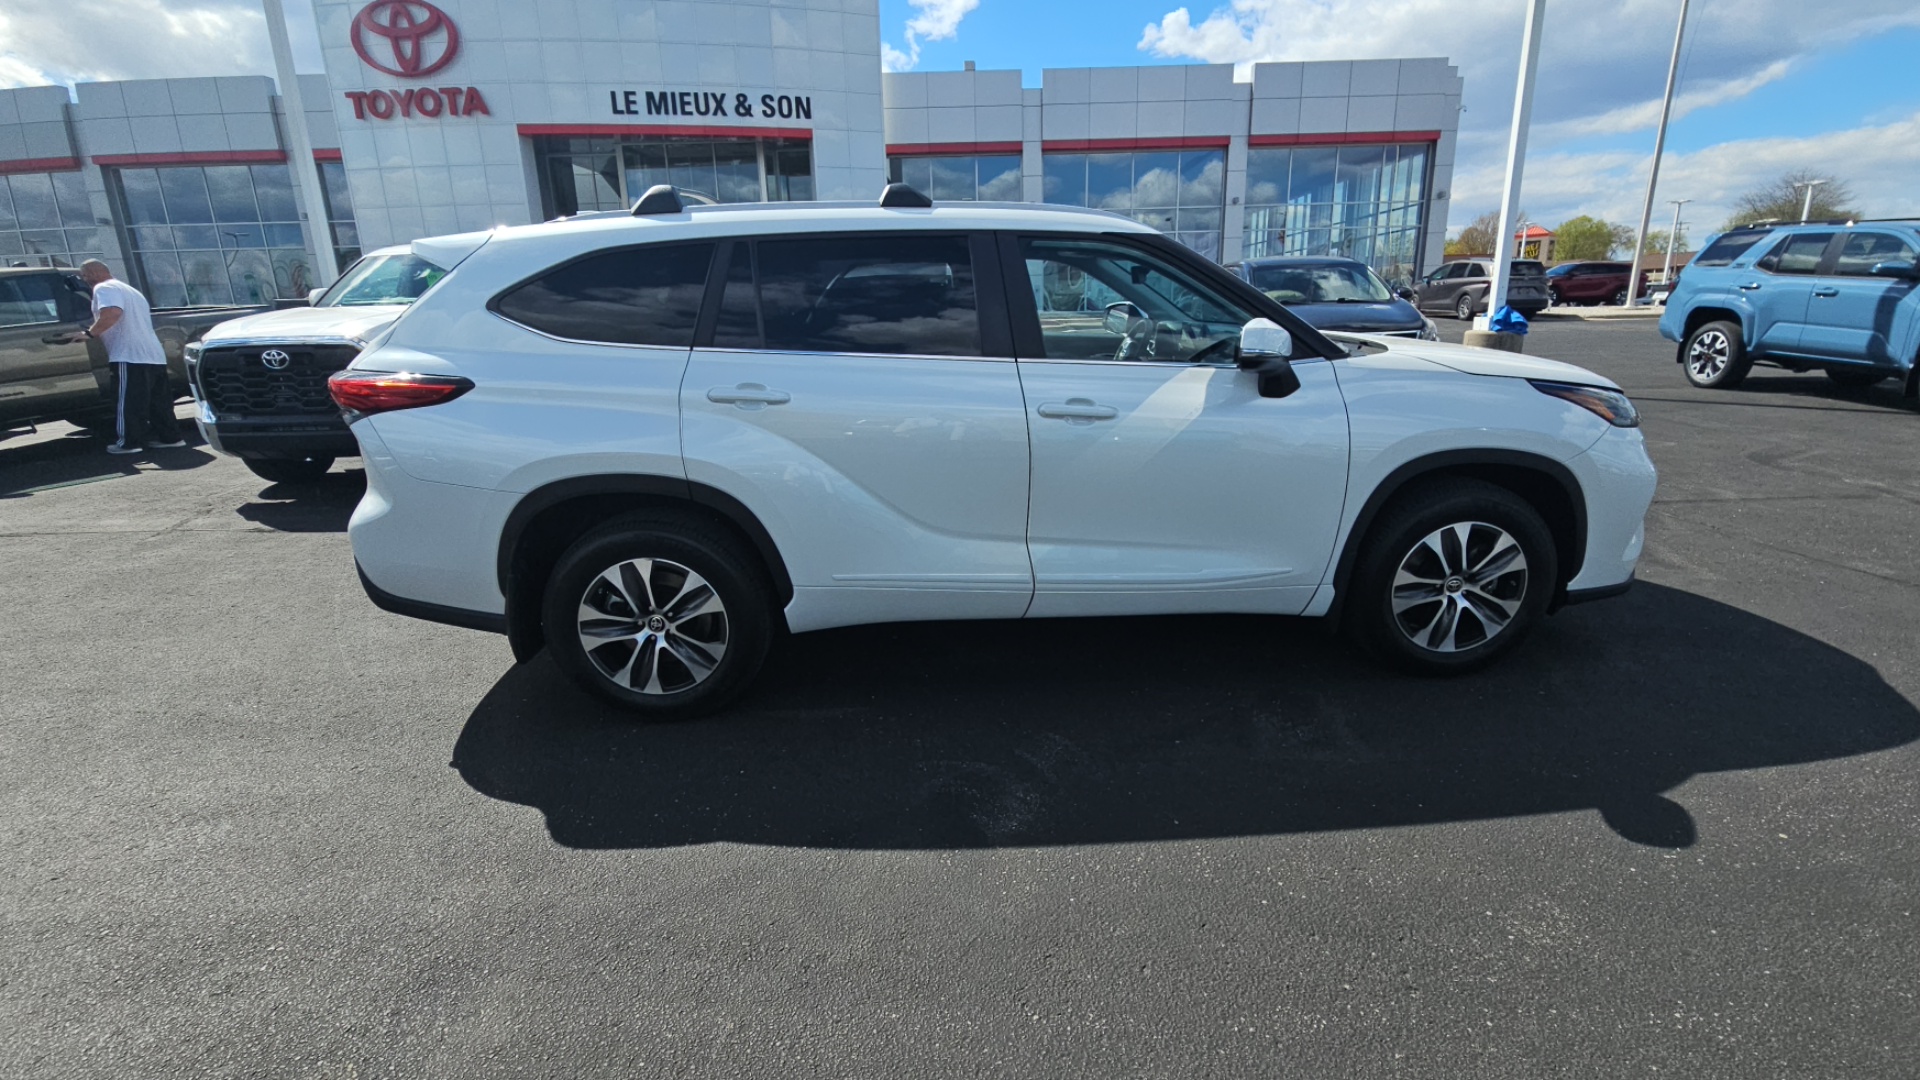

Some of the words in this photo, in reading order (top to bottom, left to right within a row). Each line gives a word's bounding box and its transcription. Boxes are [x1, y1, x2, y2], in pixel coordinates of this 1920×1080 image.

[344, 86, 490, 120] TOYOTA
[610, 90, 639, 115] LE
[645, 91, 728, 117] MIEUX
[734, 93, 754, 117] &
[760, 94, 812, 119] SON
